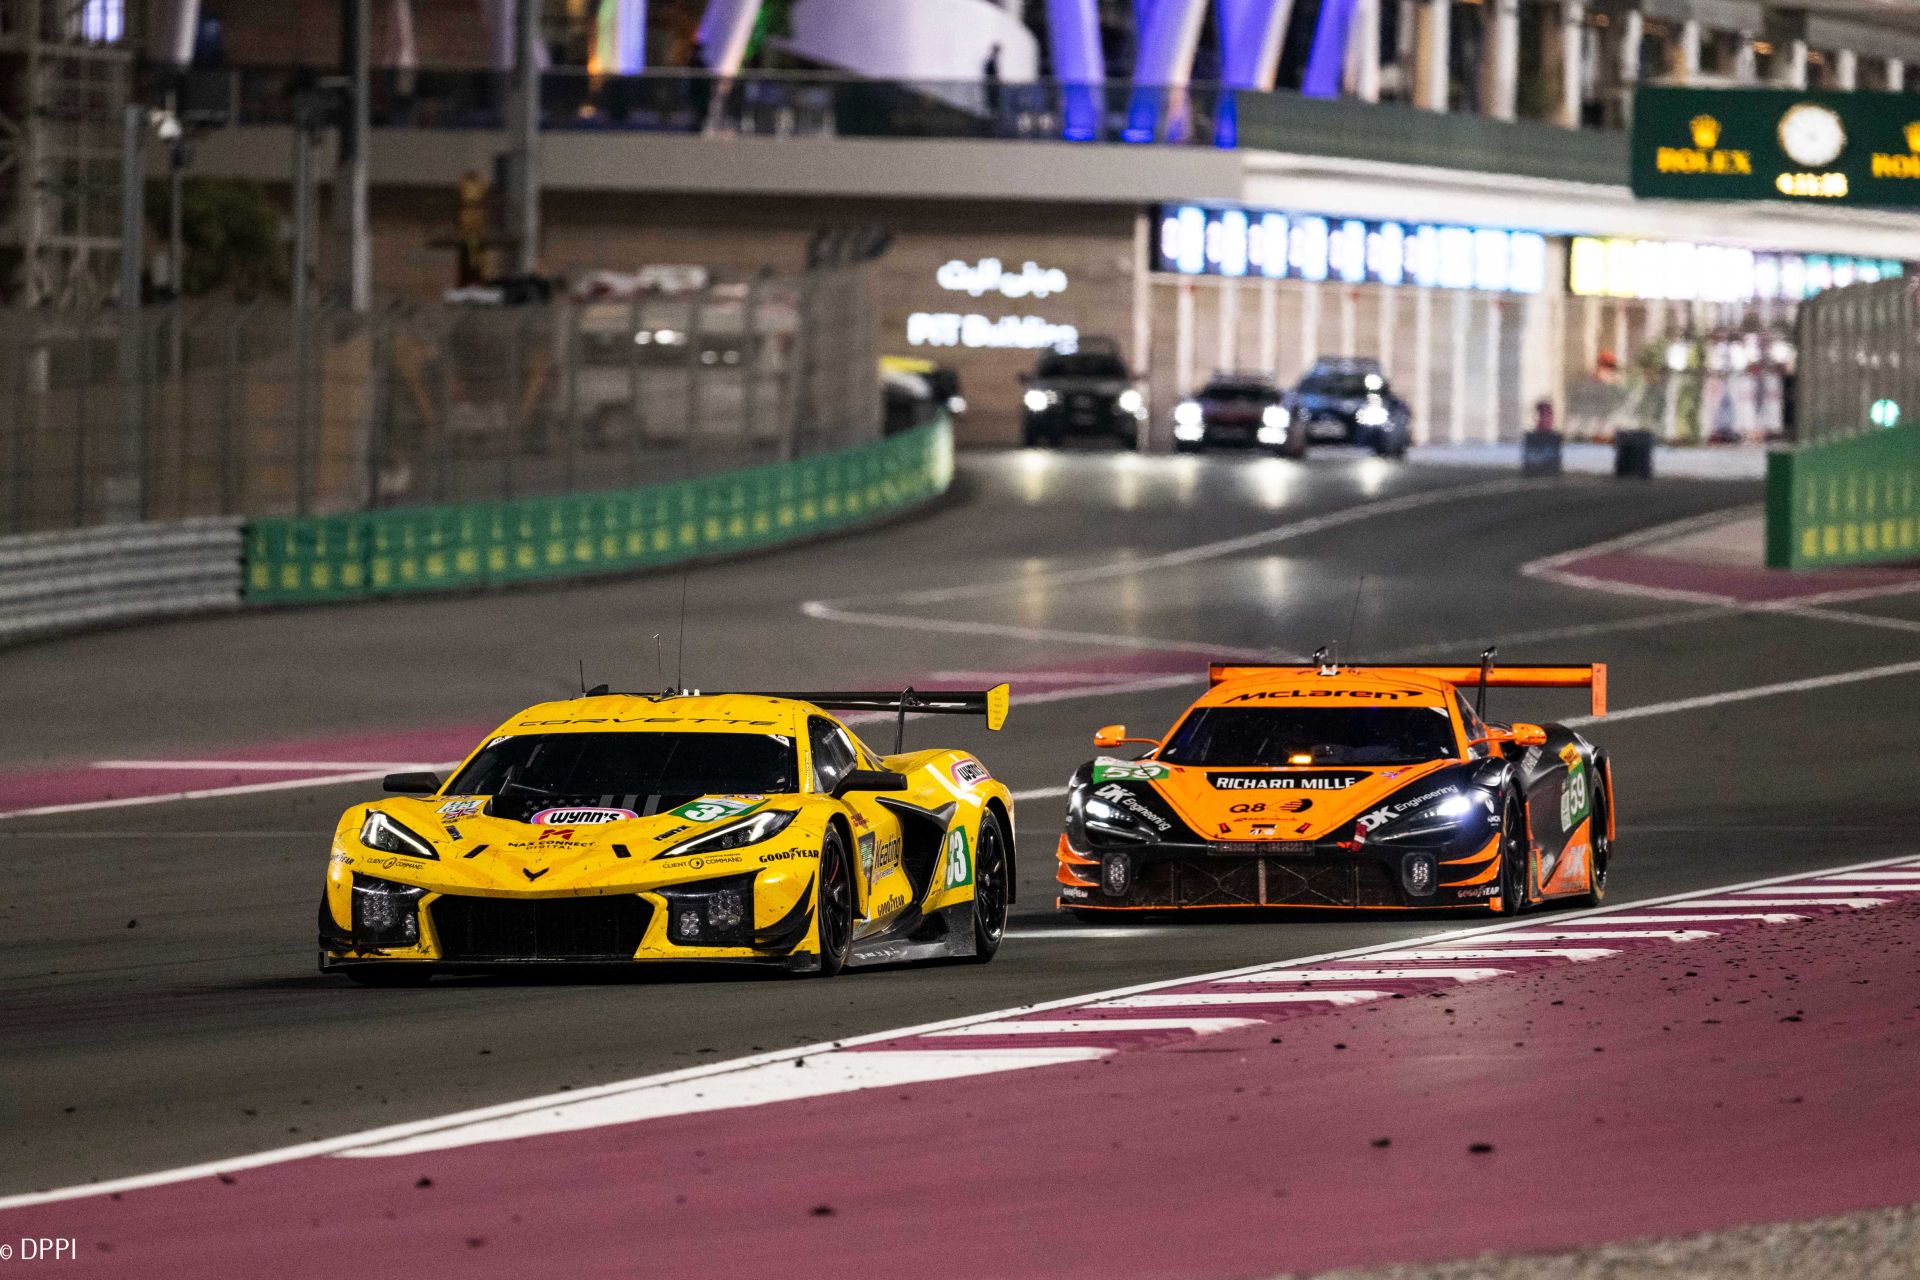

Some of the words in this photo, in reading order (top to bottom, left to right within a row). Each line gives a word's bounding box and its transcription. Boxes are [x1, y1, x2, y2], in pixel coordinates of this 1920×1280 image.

[1656, 146, 1752, 175] ROLEX
[1222, 689, 1398, 705] McLaren
[518, 717, 779, 727] CORVETTE
[1102, 766, 1162, 779] 59
[1216, 777, 1295, 790] RICHARD
[1301, 777, 1355, 790] MILLE
[1570, 772, 1585, 815] 59
[1094, 783, 1136, 803] DK
[1122, 797, 1173, 832] Engineering
[1229, 802, 1266, 813] Q8
[1356, 805, 1400, 832] DK
[1394, 784, 1459, 812] Engineering
[705, 857, 743, 865] COMMAND
[759, 848, 819, 863] GOODYEAR
